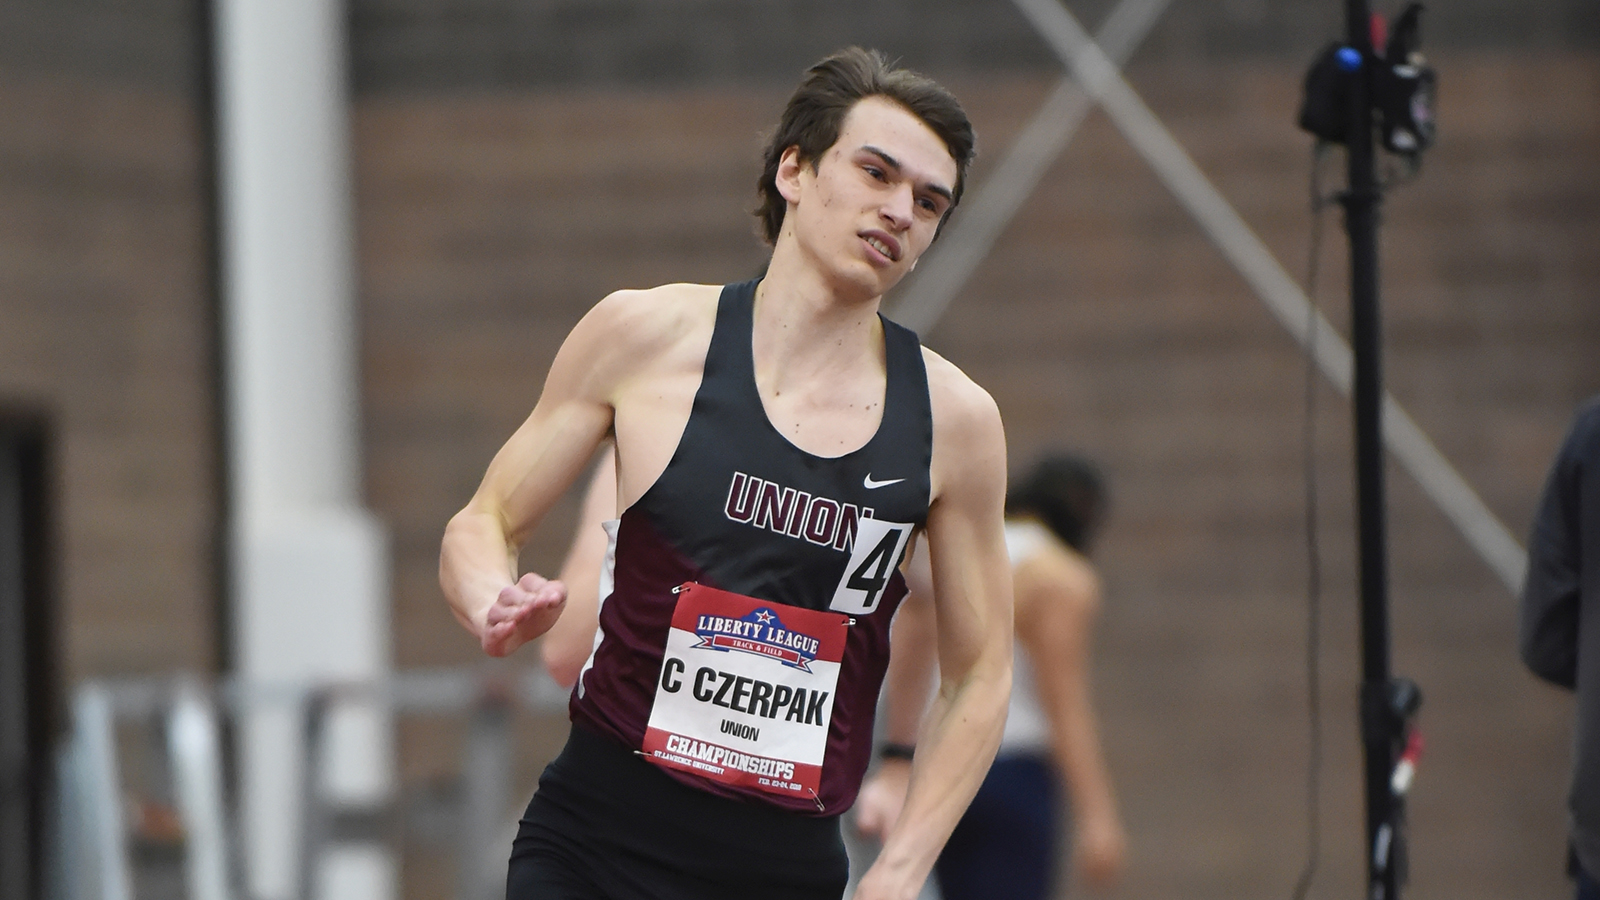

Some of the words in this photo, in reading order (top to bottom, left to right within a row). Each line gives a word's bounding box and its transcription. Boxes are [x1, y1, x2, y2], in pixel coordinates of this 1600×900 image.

[725, 471, 874, 554] UNION
[846, 528, 904, 608] 4
[698, 616, 763, 639] LIBERTY
[766, 627, 819, 655] LEAGUE
[732, 640, 754, 649] TRACK
[764, 646, 783, 657] FIELD
[661, 658, 685, 693] C
[693, 667, 829, 727] CZERPAK
[720, 719, 760, 742] UNION
[666, 735, 795, 780] CHAMPIONSHIPS
